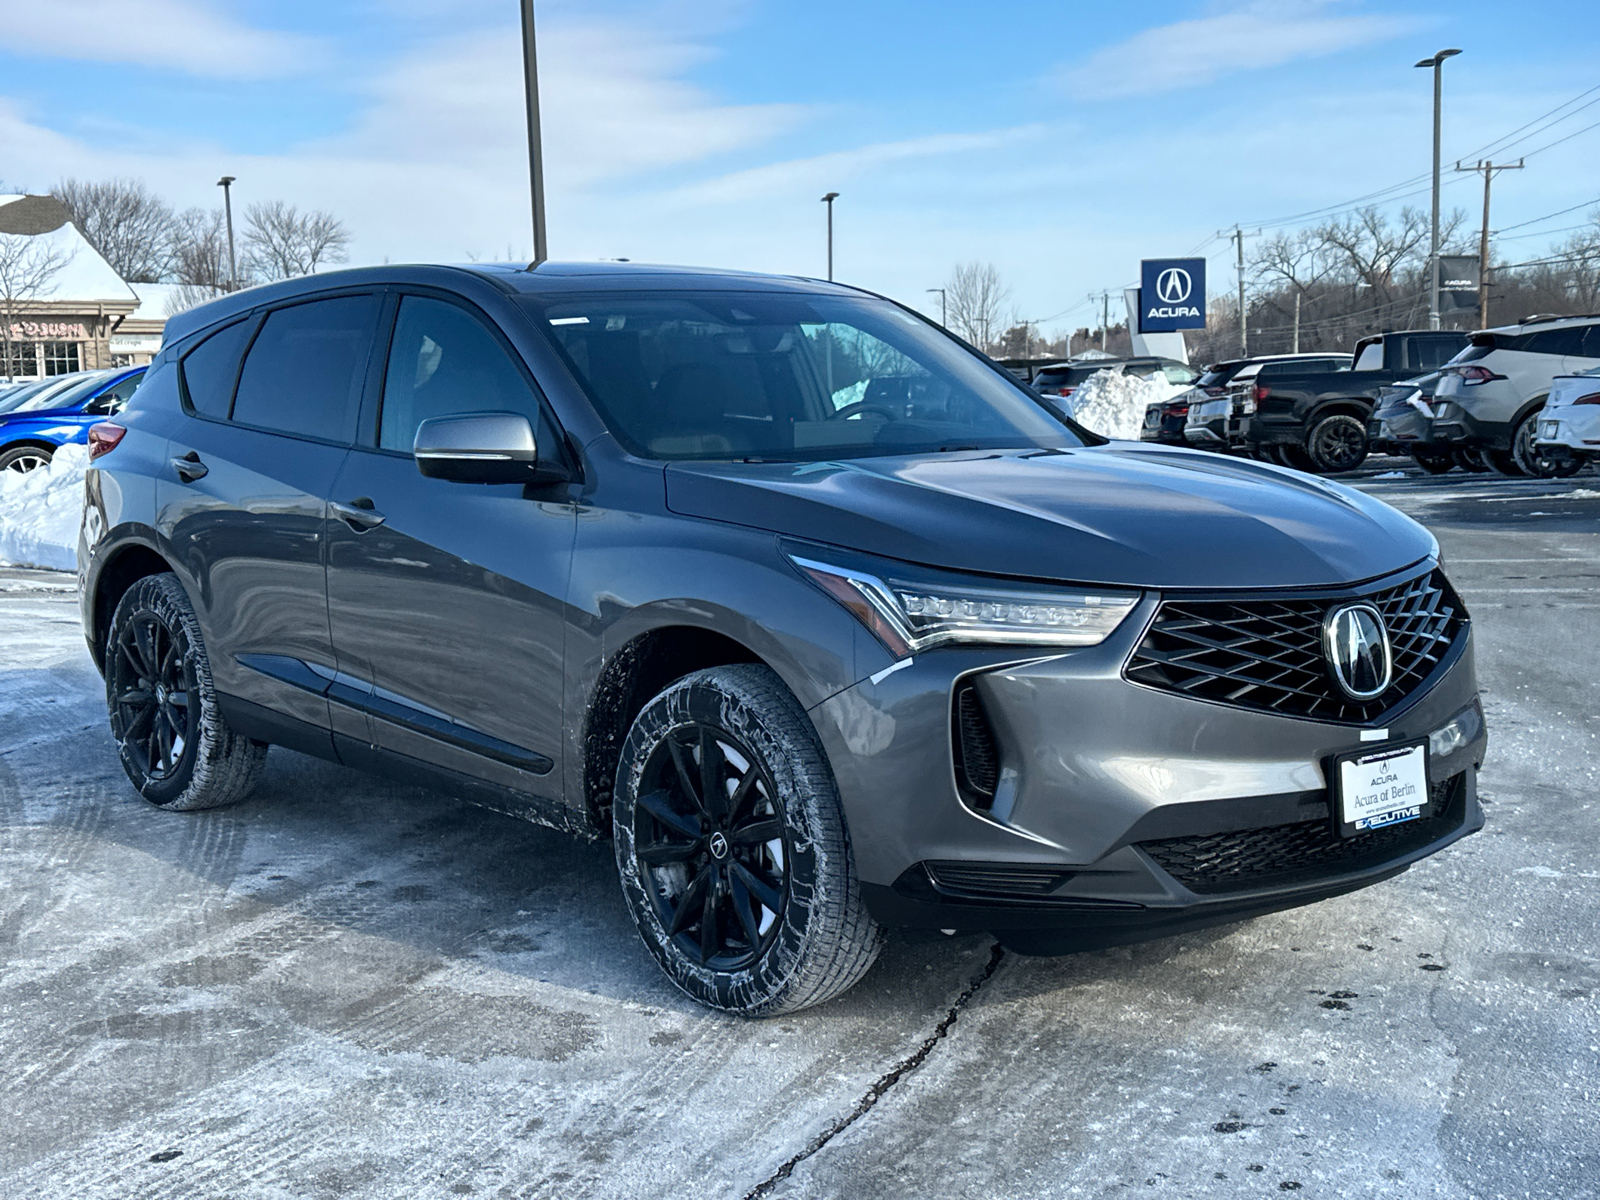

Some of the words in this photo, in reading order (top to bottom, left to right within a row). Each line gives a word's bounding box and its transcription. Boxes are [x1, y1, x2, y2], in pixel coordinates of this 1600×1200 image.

[1147, 306, 1200, 318] ACURA
[1371, 773, 1398, 787] ACURA
[1354, 795, 1379, 808] Acura
[1380, 789, 1389, 802] of
[1391, 783, 1416, 799] Berlin
[1355, 806, 1421, 830] EXECUTIVE
